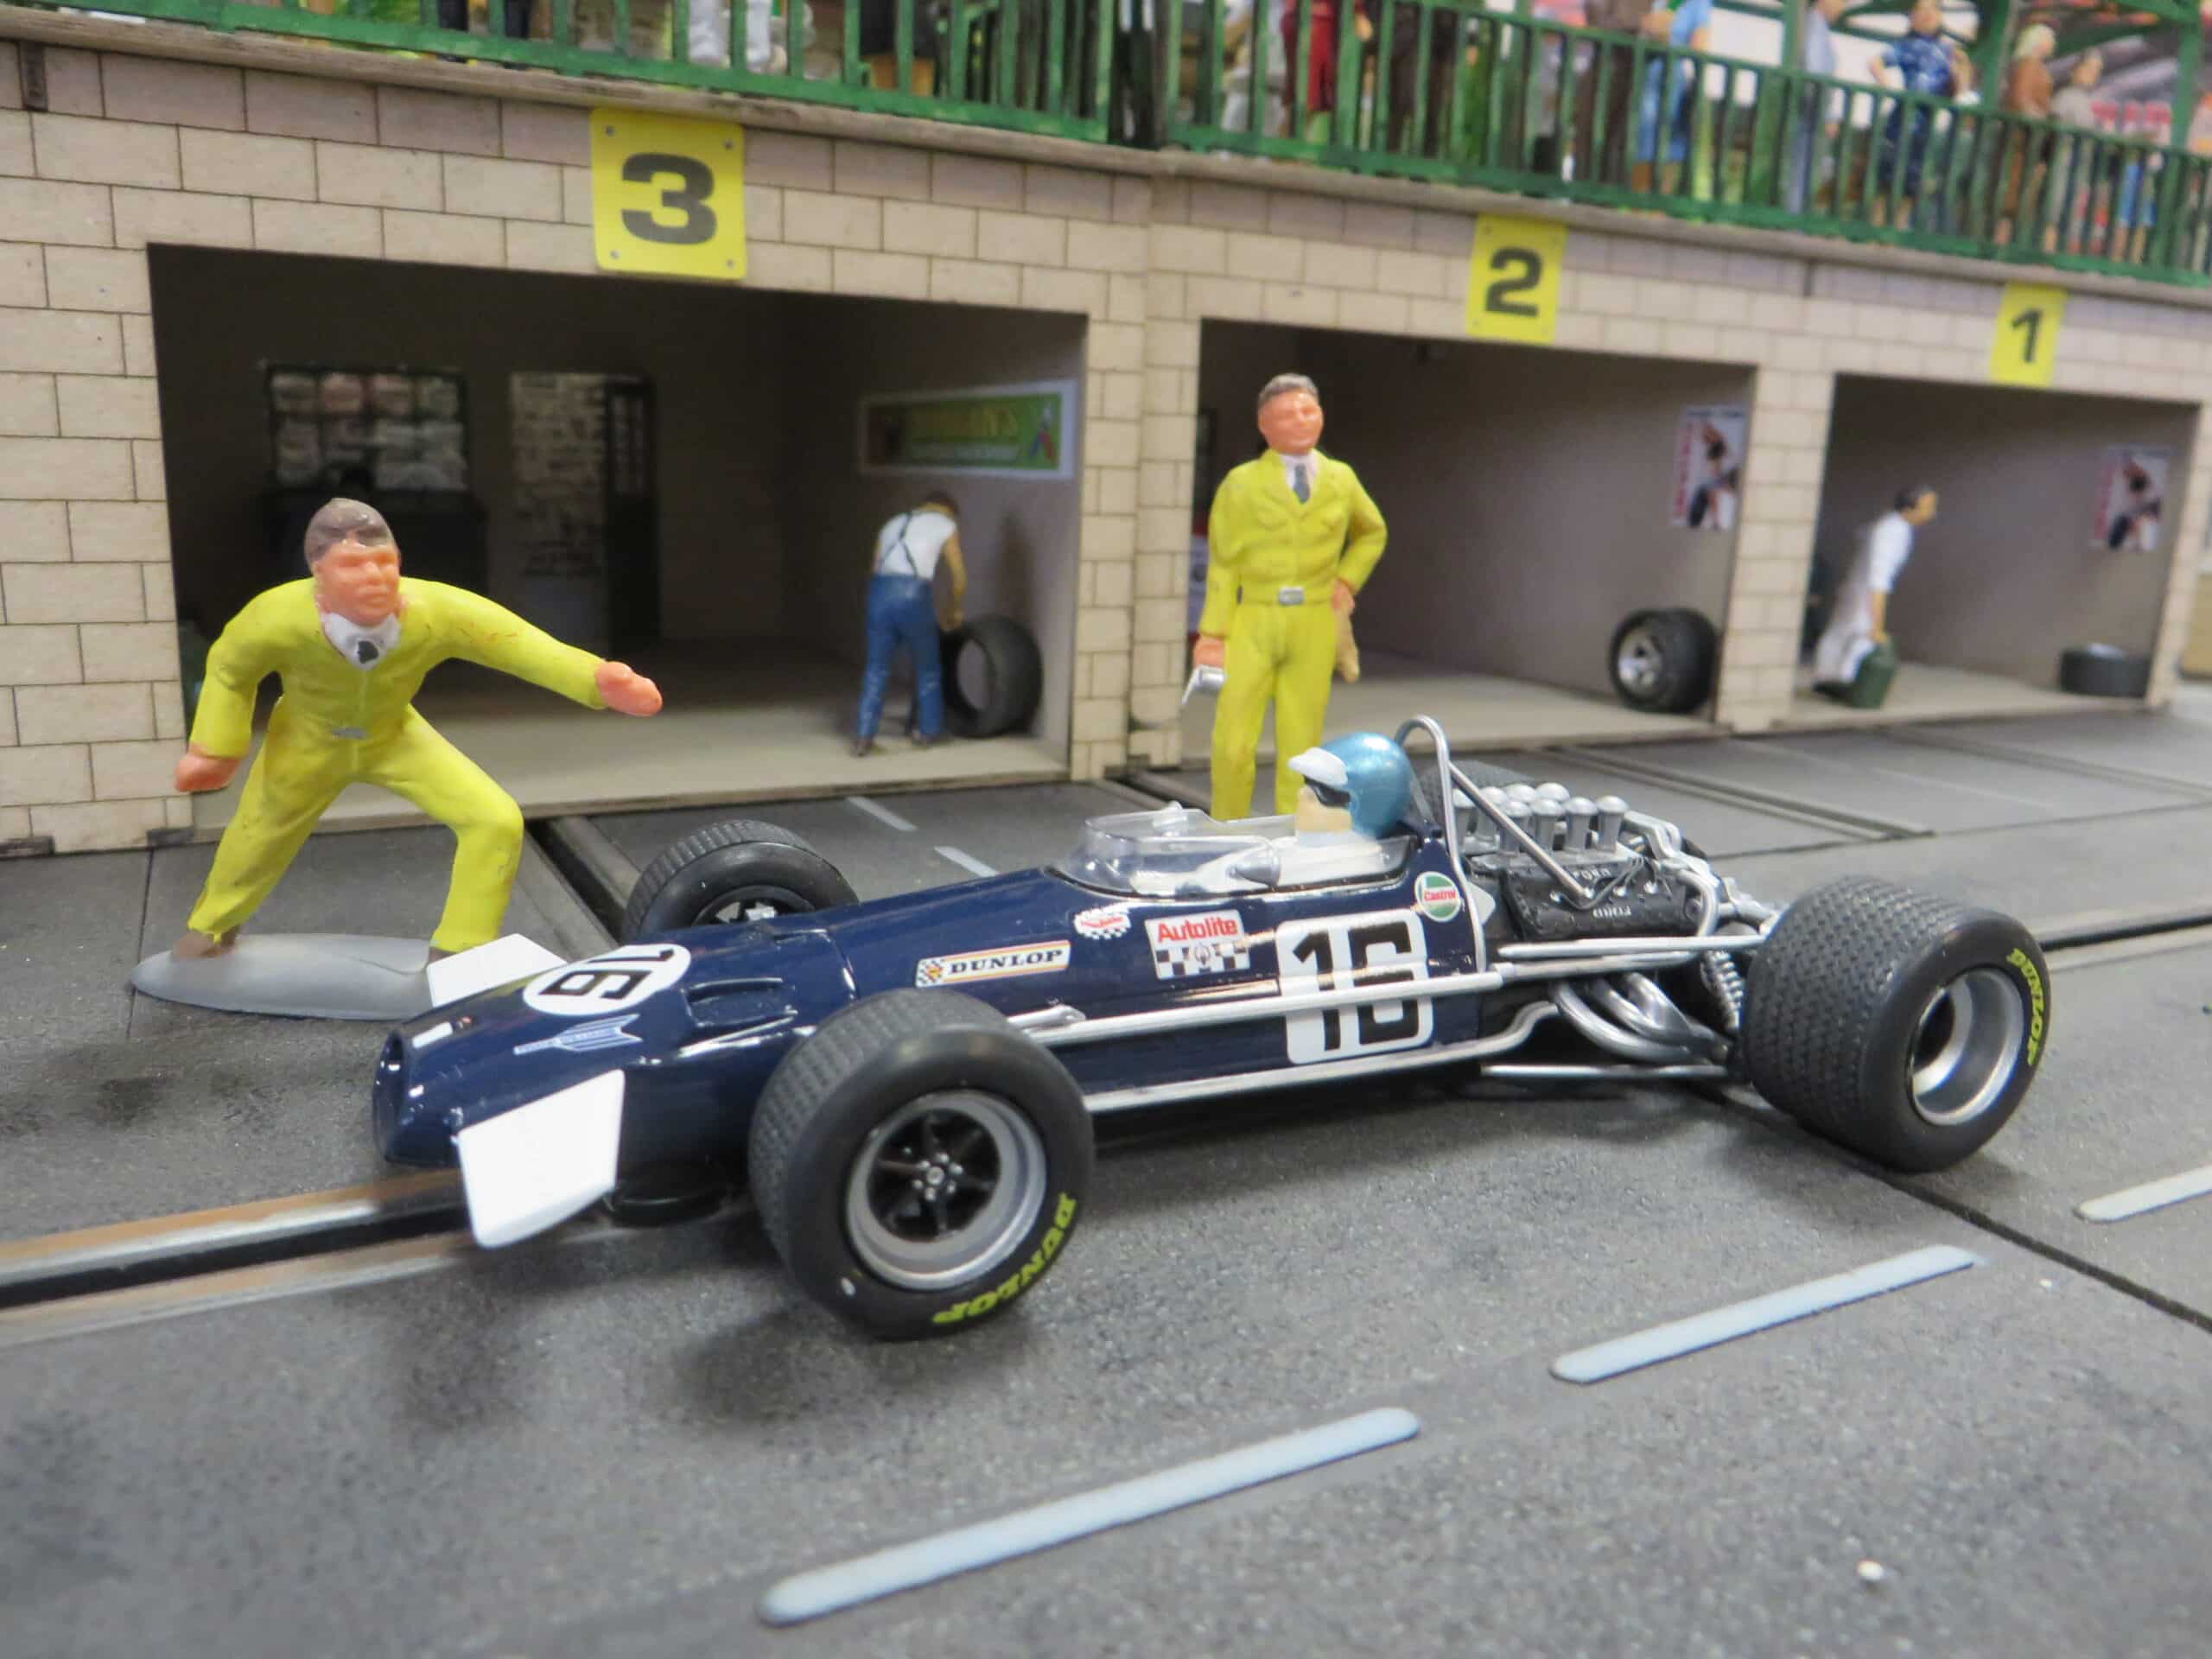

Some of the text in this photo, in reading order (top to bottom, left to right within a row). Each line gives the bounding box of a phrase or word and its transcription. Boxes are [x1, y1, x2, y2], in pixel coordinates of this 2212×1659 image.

[621, 152, 717, 245] 3
[1484, 246, 1542, 318] 2
[2011, 308, 2044, 363] 1
[1158, 917, 1239, 943] Autolite
[1424, 889, 1457, 901] Castrol
[951, 949, 1063, 975] DUNLOP
[1293, 921, 1420, 1052] 16
[2006, 948, 2044, 1065] DUNLOP
[932, 1192, 1077, 1324] DUNLOP
